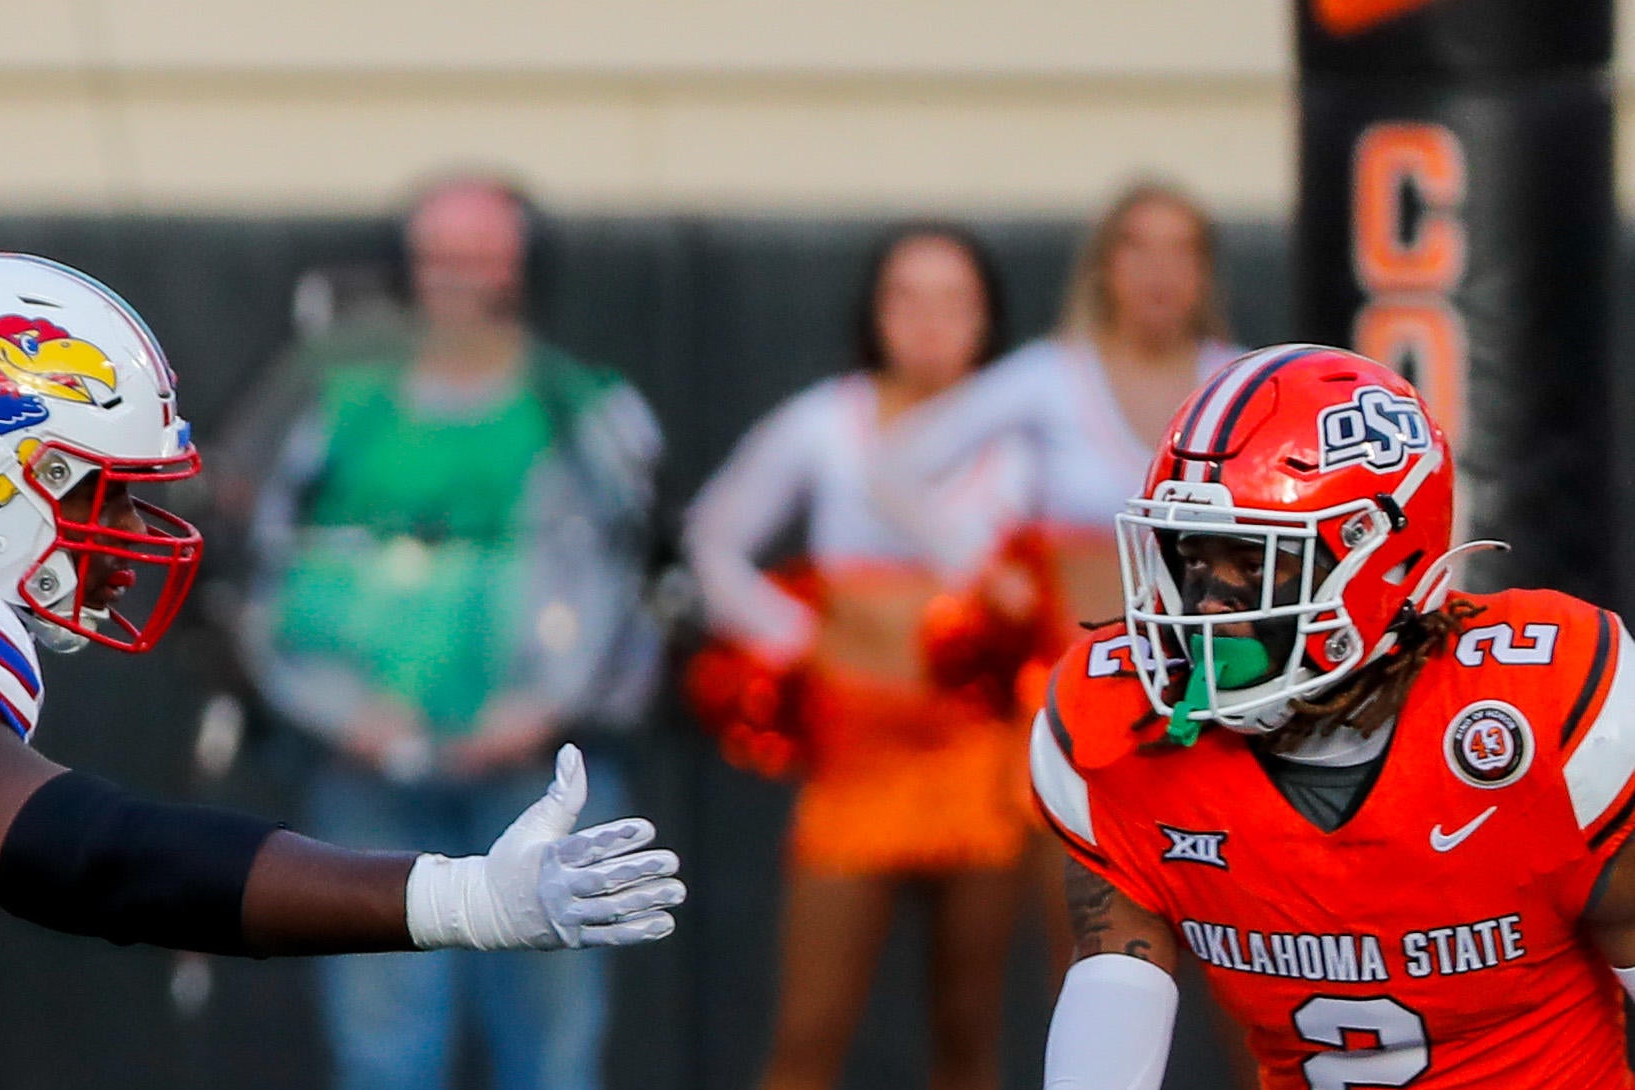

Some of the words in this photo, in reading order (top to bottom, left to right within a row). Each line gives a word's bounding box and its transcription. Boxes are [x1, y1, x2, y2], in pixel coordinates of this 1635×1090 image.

[1317, 385, 1433, 474] OSU
[1454, 621, 1559, 667] 2
[1469, 726, 1507, 761] 43
[1160, 824, 1229, 869] XII
[1180, 919, 1390, 983] OKLAHOMA
[1402, 913, 1526, 979] STATE
